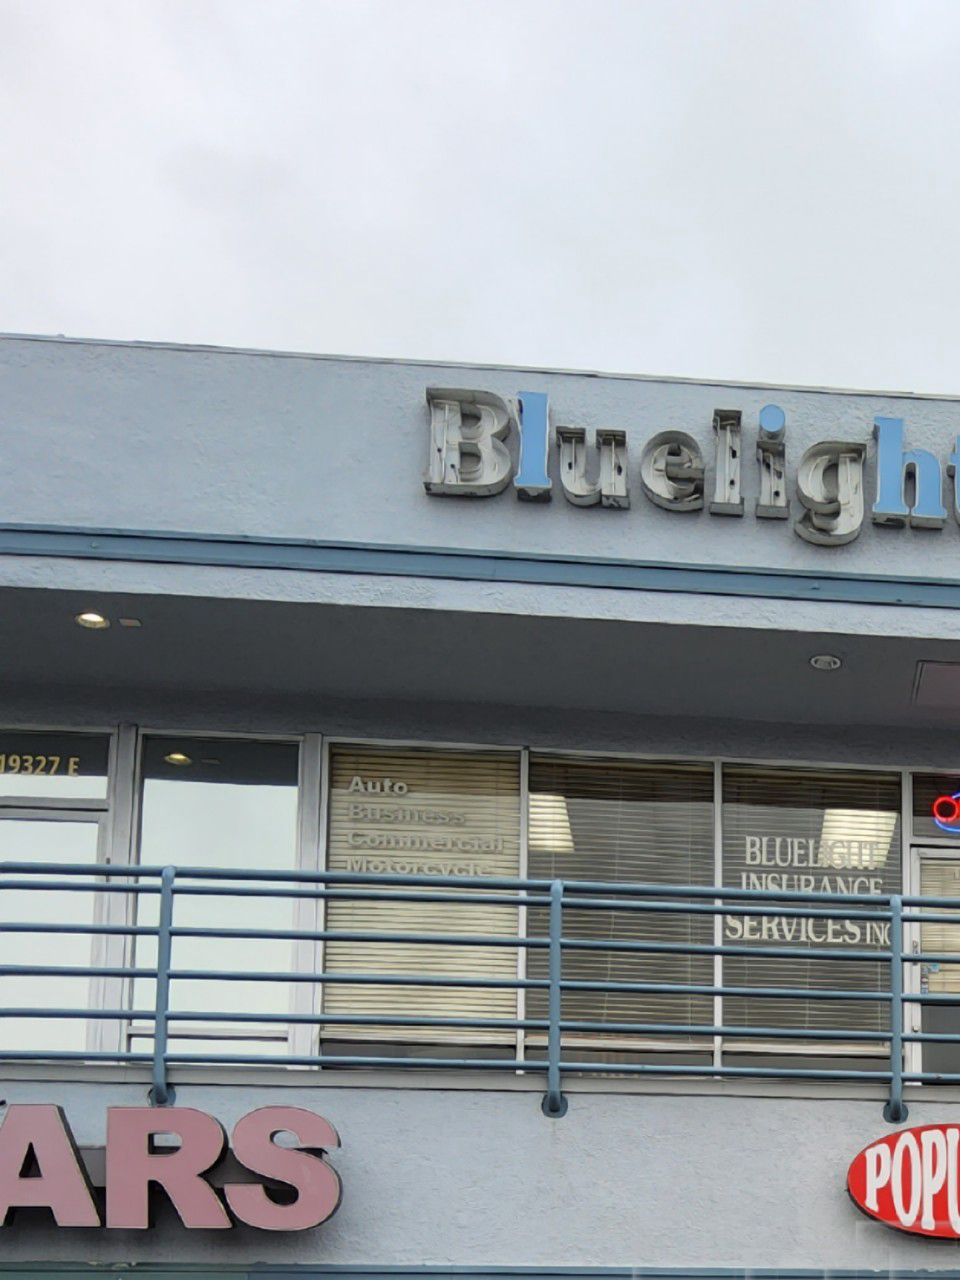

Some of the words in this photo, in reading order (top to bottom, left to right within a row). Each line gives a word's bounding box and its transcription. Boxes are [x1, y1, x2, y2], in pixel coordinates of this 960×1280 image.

[0, 754, 60, 776] 19327
[68, 757, 80, 777] E
[349, 776, 408, 795] Auto
[348, 803, 466, 825] Business
[347, 832, 505, 855] Commercial
[744, 836, 880, 870] BLUELIGHT
[740, 872, 884, 897] INSURANCE
[725, 915, 862, 944] SERVICES
[0, 1104, 343, 1231] ARS
